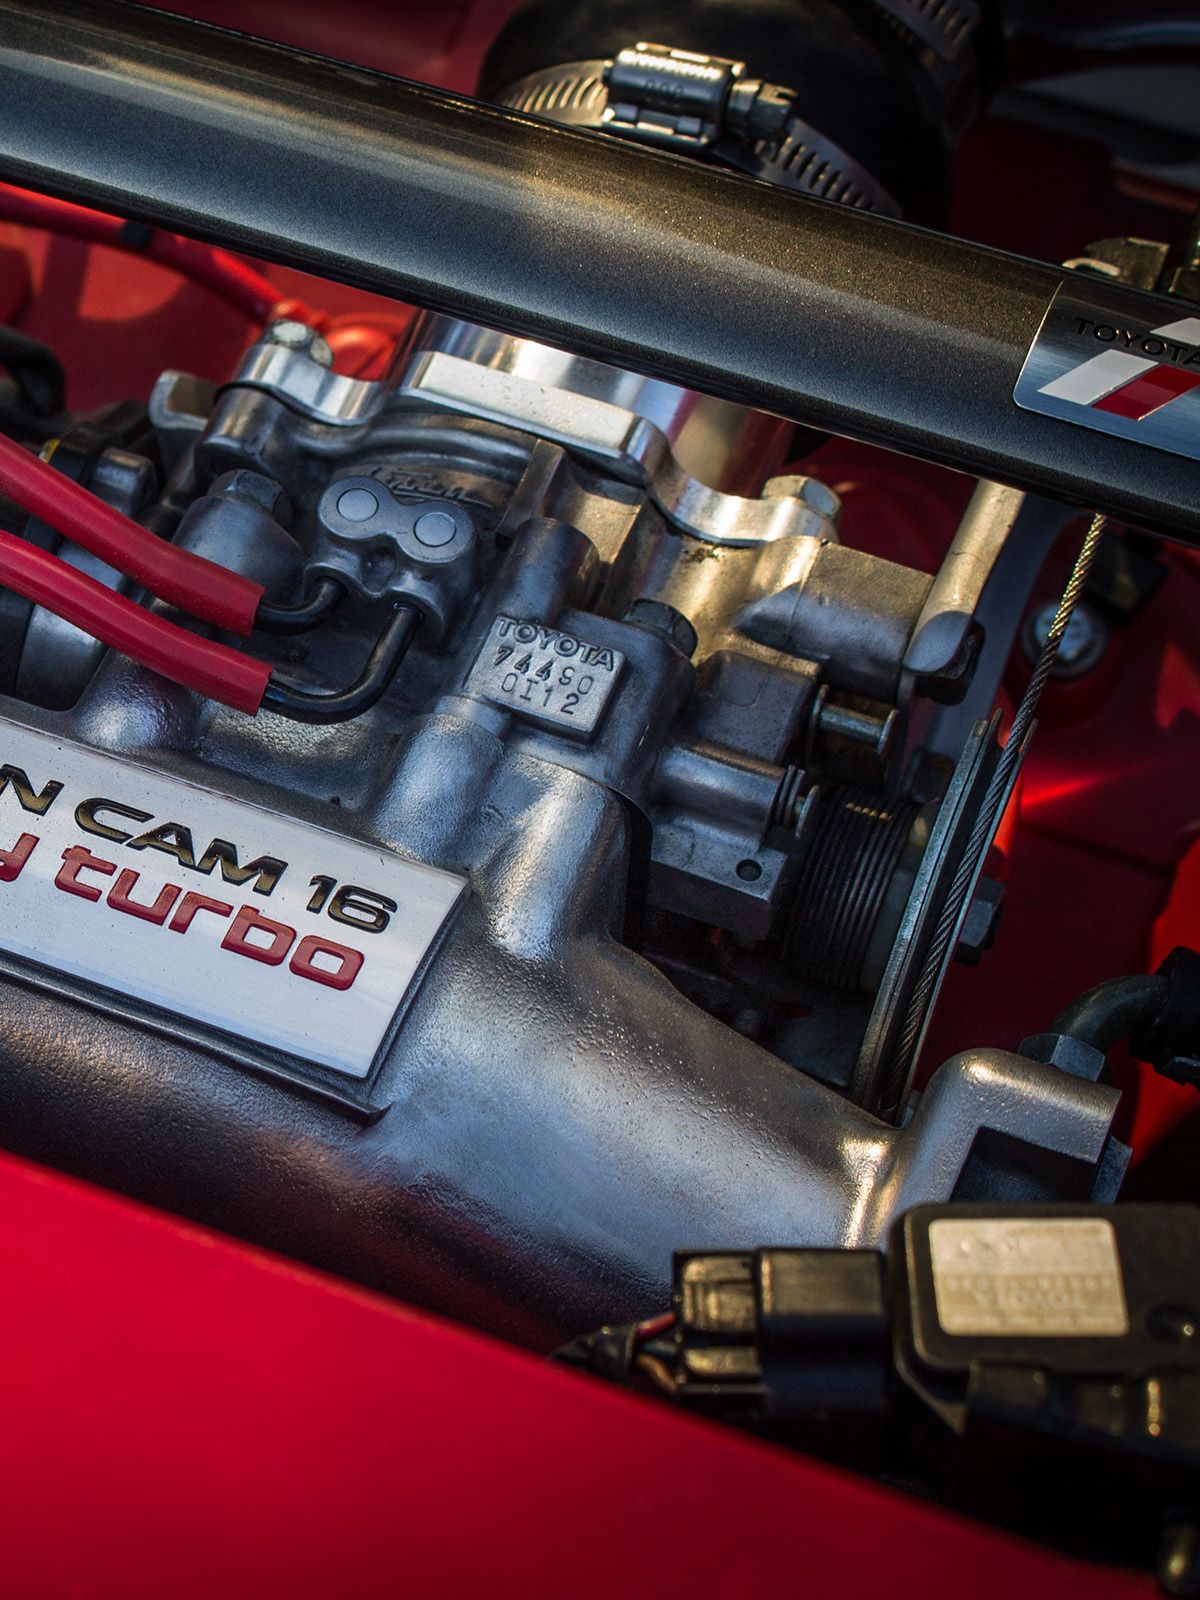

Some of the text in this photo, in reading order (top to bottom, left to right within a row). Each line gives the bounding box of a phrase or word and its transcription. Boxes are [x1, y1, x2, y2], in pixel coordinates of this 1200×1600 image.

[1074, 316, 1200, 366] TOYOTA
[498, 618, 615, 672] TOYOTA
[74, 797, 289, 896] CAM
[305, 873, 399, 934] 16
[54, 844, 366, 992] turbo
